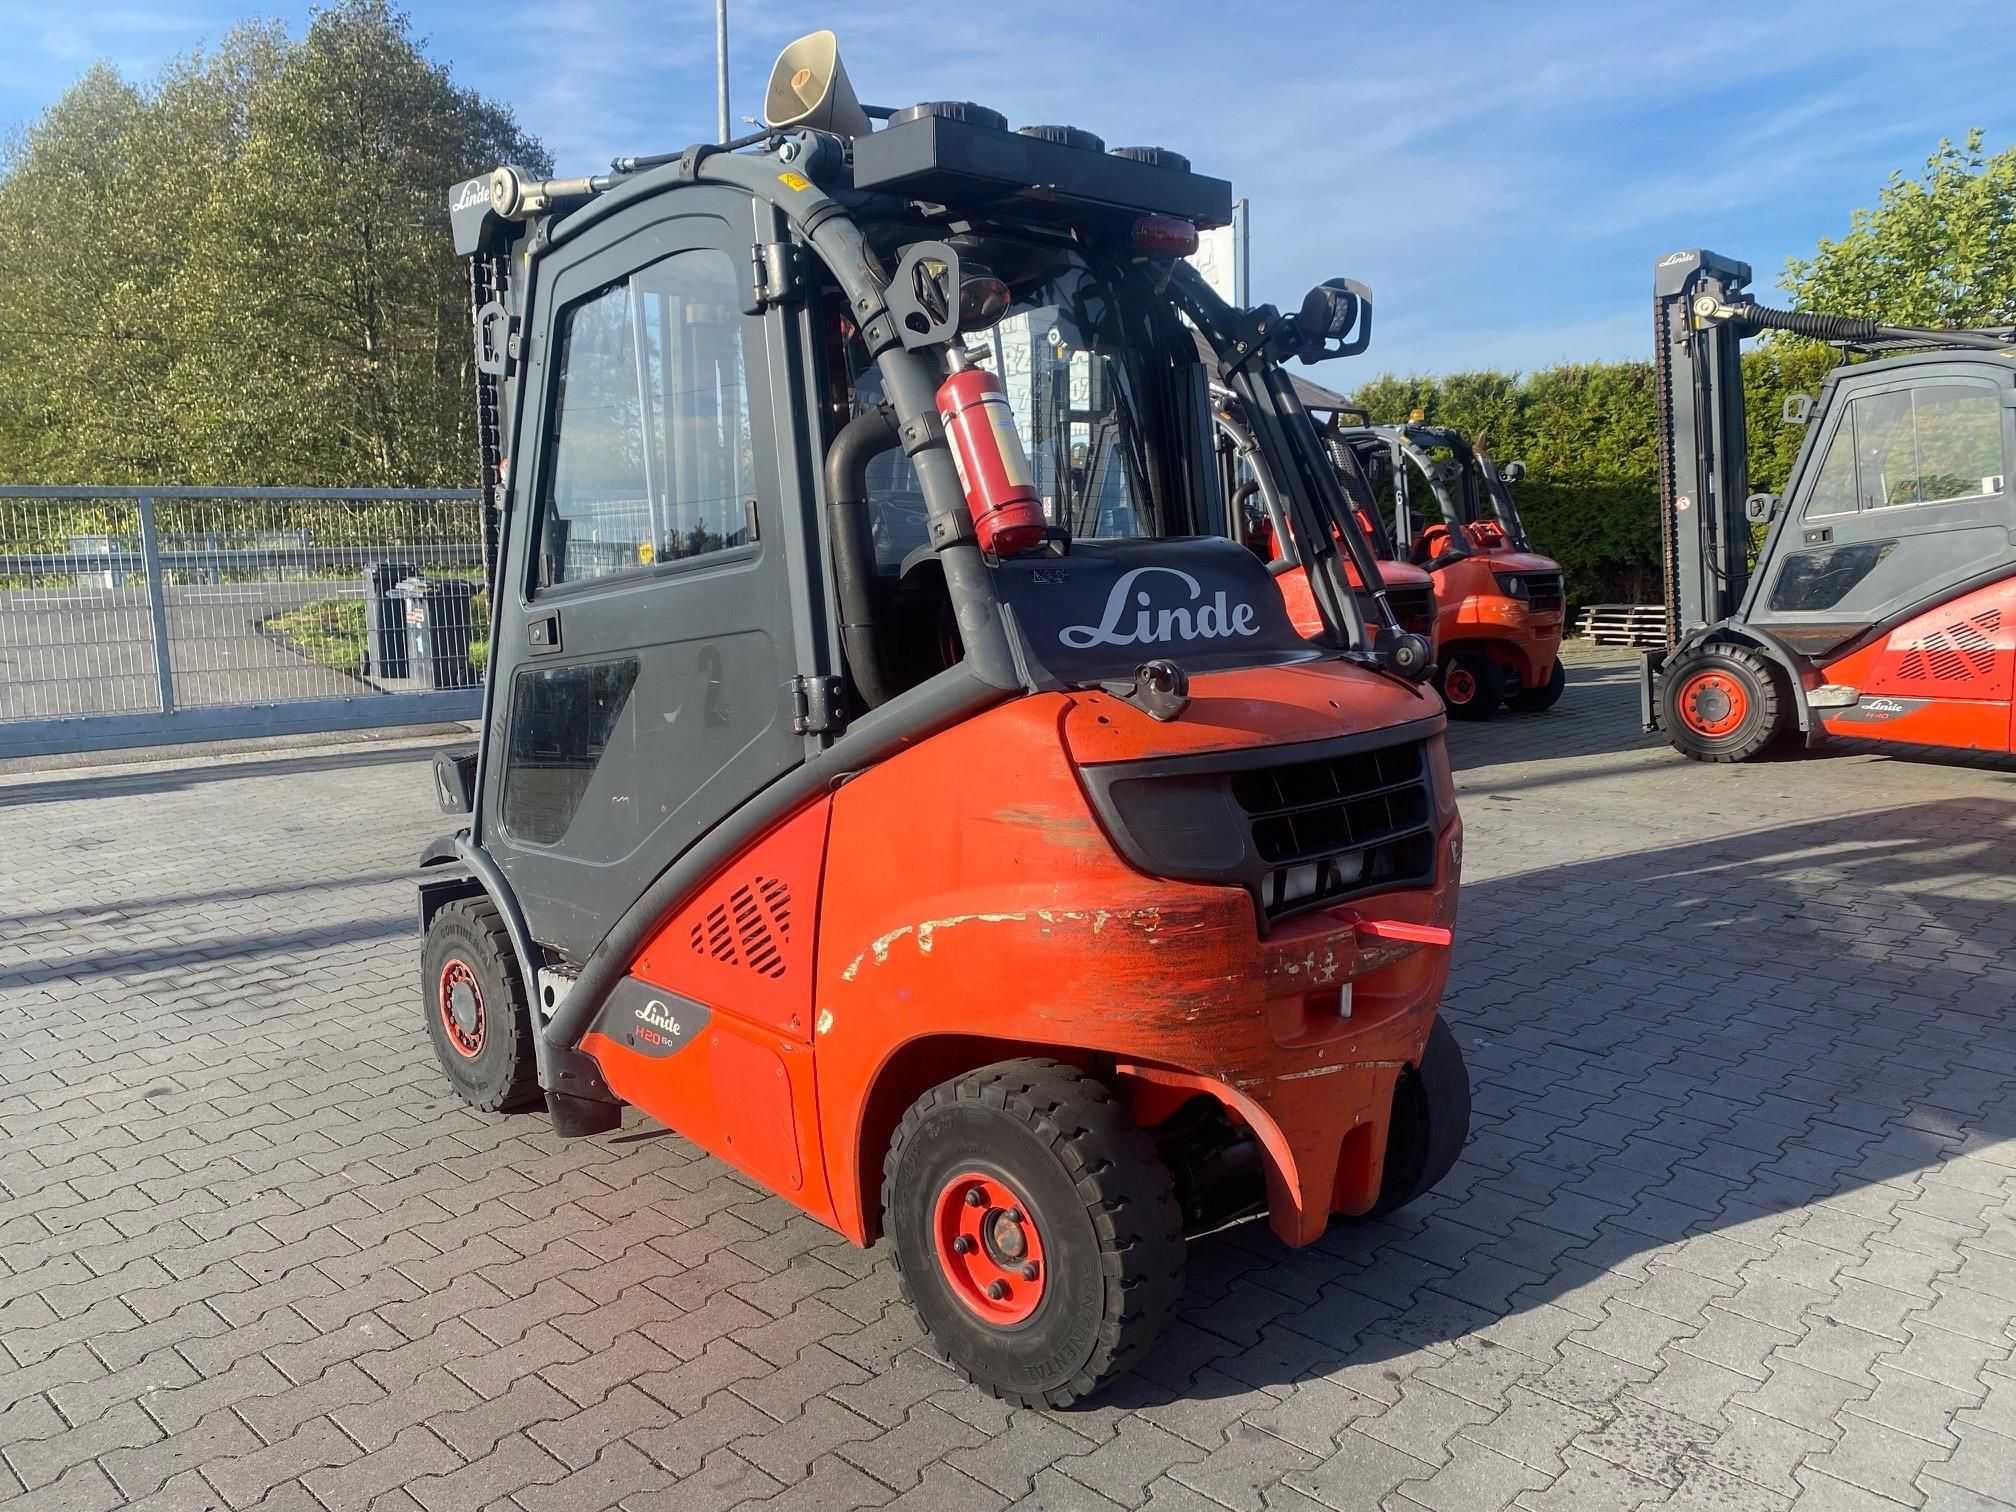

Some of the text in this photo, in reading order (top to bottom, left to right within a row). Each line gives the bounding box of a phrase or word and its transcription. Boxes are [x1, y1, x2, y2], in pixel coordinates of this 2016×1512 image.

[452, 180, 490, 212] Linde
[1658, 251, 1695, 267] Linde
[1395, 490, 1403, 505] 6
[1058, 566, 1261, 649] Linde
[1861, 699, 1903, 712] Linde
[634, 999, 681, 1036] Linde
